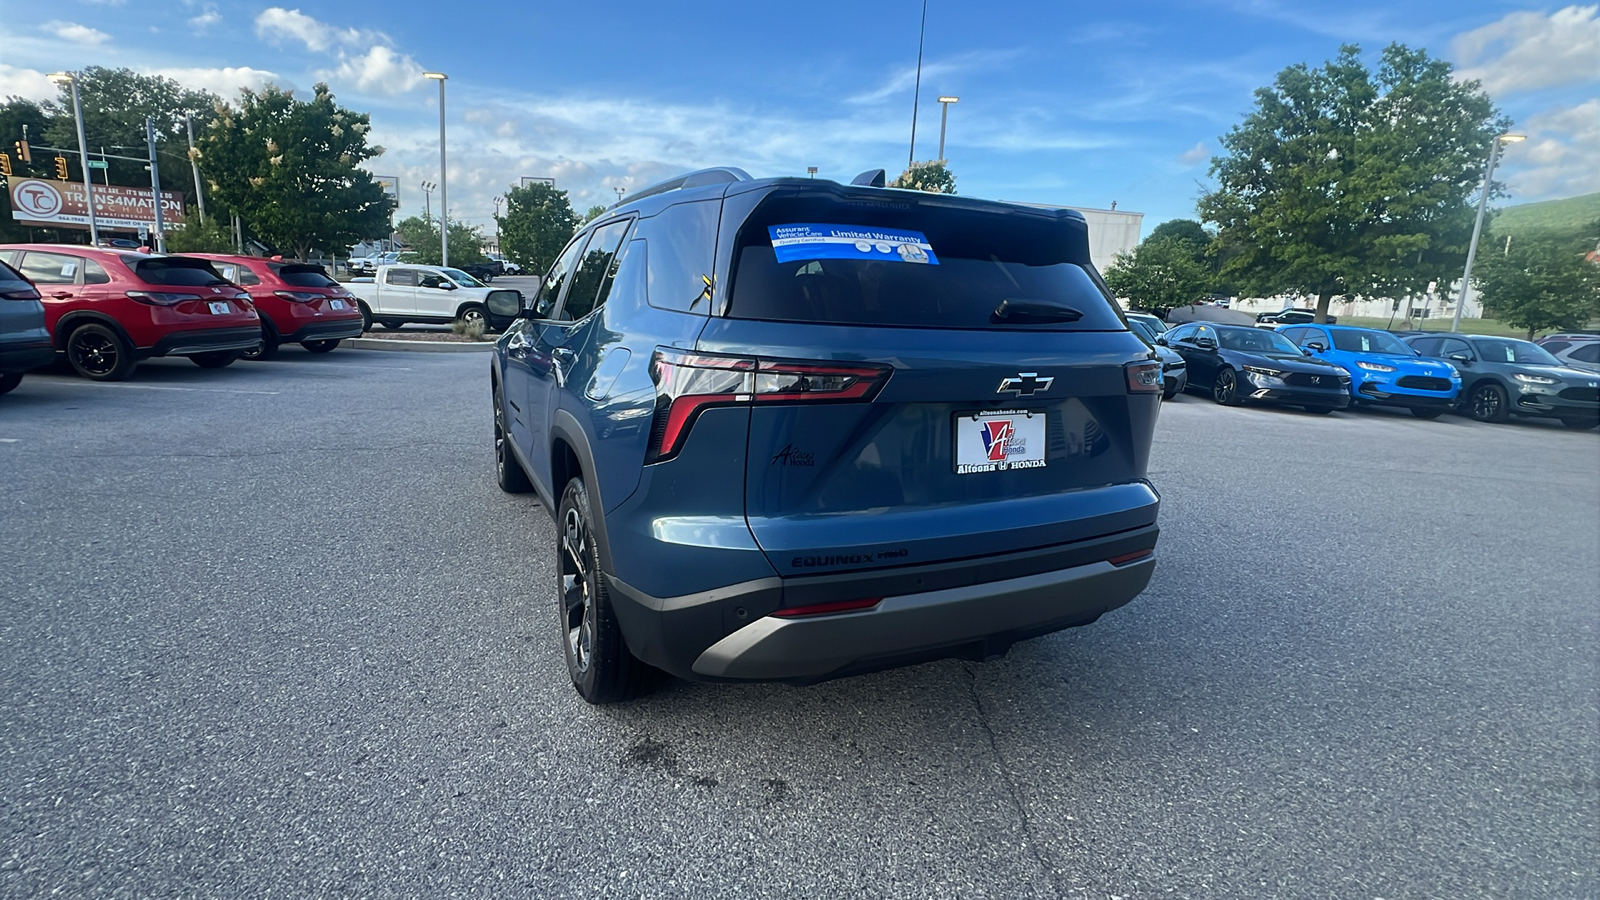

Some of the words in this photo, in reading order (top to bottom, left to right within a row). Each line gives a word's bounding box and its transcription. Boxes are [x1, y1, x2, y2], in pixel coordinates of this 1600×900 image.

[64, 191, 181, 210] TRNS4MATON
[777, 231, 805, 239] Vehicle
[831, 230, 872, 239] Limited
[872, 232, 921, 244] Warranty
[1003, 446, 1026, 455] Honda
[957, 463, 996, 474] Altoona
[1011, 460, 1047, 469] HONDA
[791, 553, 873, 568] EQUINOX
